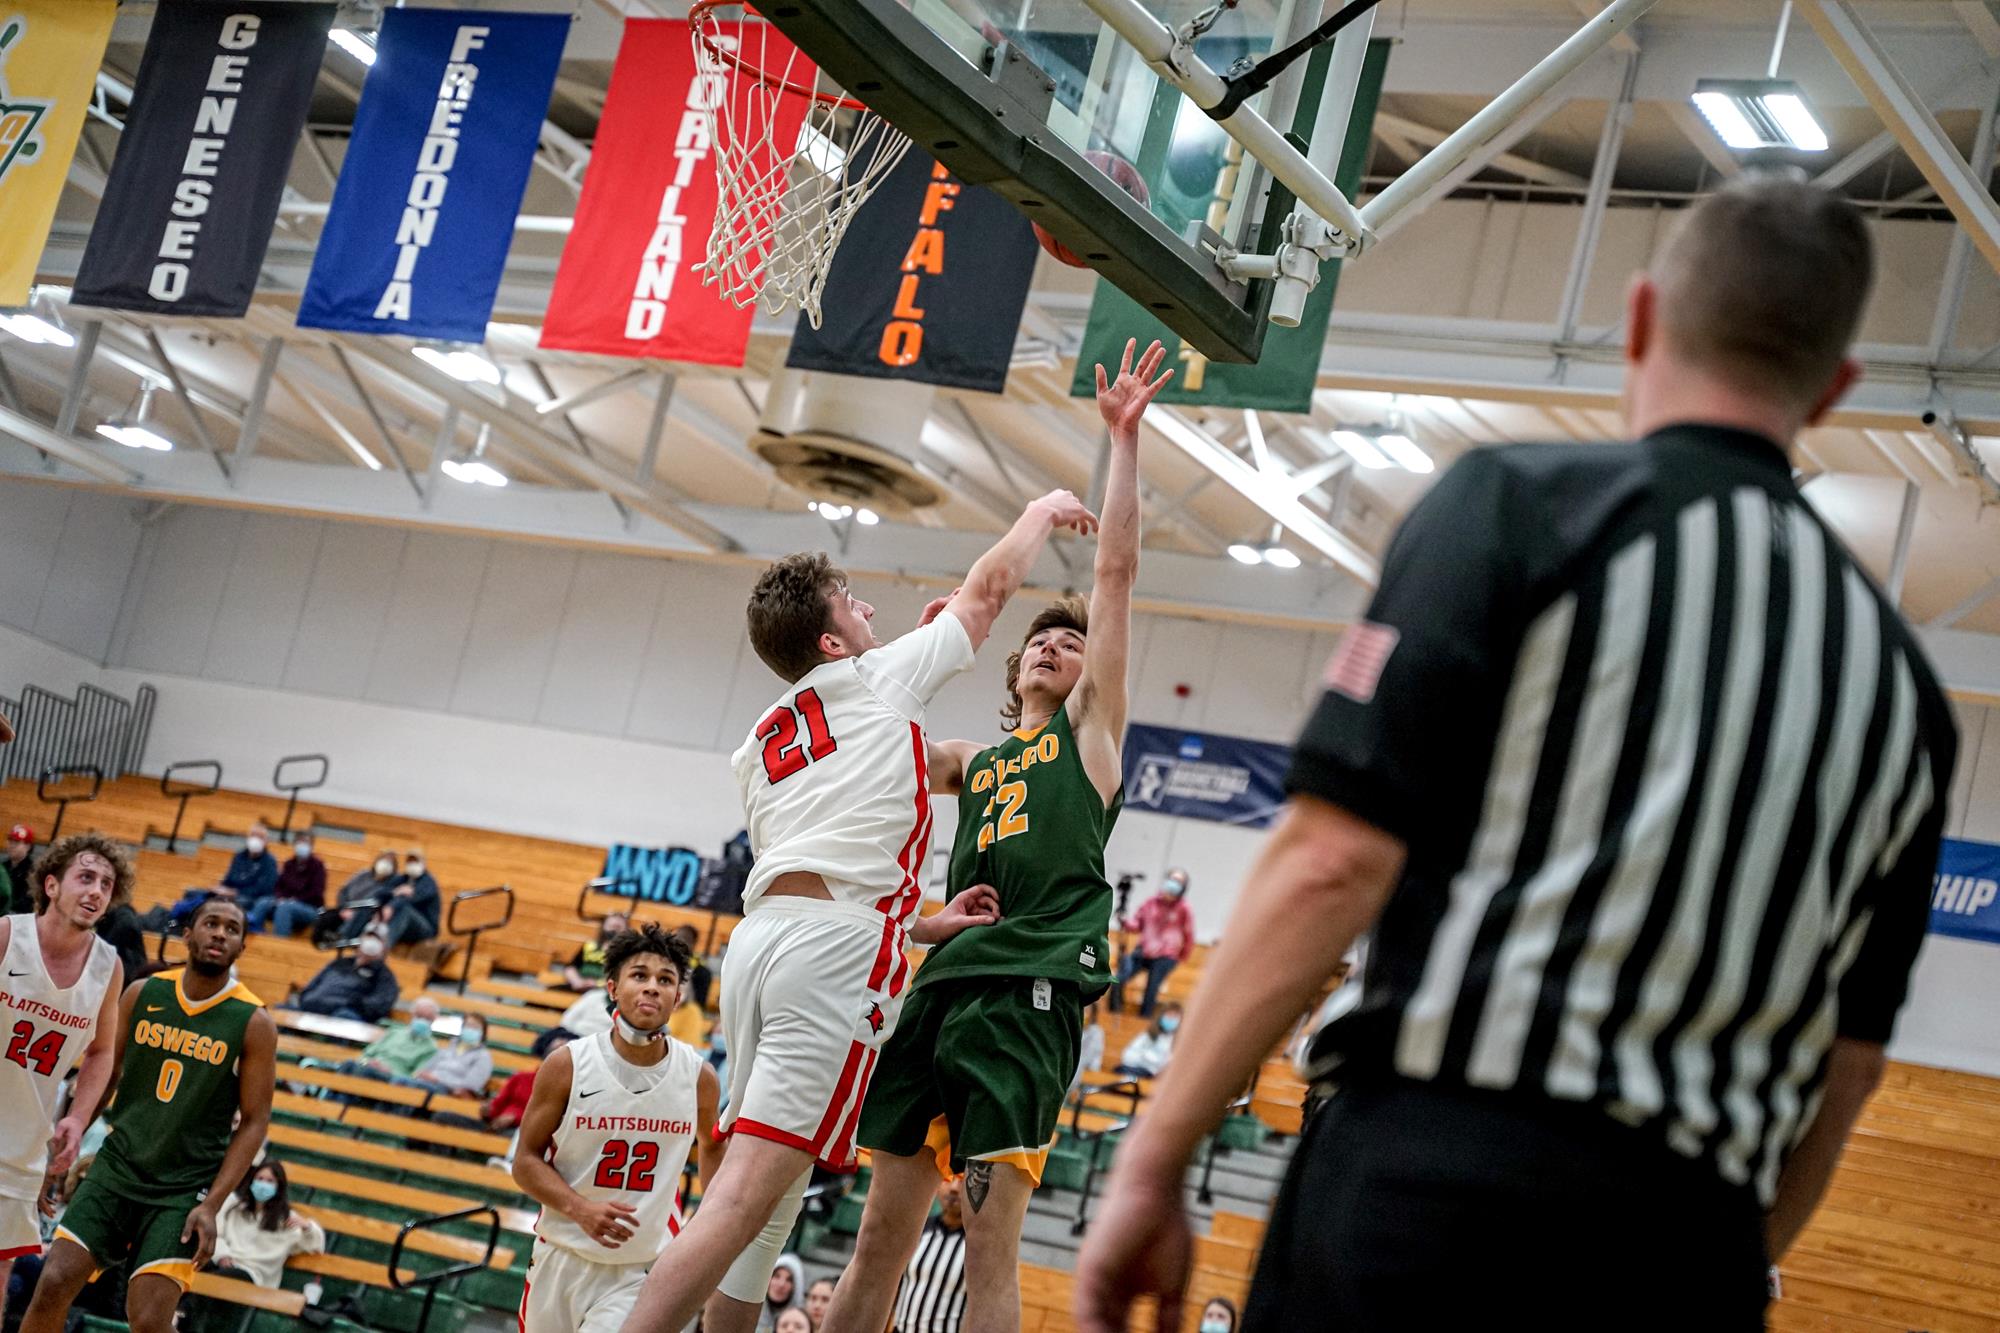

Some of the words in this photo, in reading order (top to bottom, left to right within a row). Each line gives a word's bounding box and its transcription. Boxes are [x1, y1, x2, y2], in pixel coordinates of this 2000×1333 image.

[148, 13, 261, 302] GENESEO
[373, 25, 490, 321] FREDONIA
[624, 34, 739, 340] CORTLAND
[755, 686, 837, 785] 21
[970, 733, 1060, 794] OEGO
[1930, 872, 1998, 916] HIP
[1084, 944, 1095, 955] XL
[5, 1019, 67, 1077] 24
[134, 1020, 228, 1066] OSWEGO
[156, 1058, 183, 1103] 0
[575, 1116, 692, 1135] PLATTSBURGH
[593, 1139, 660, 1192] 22
